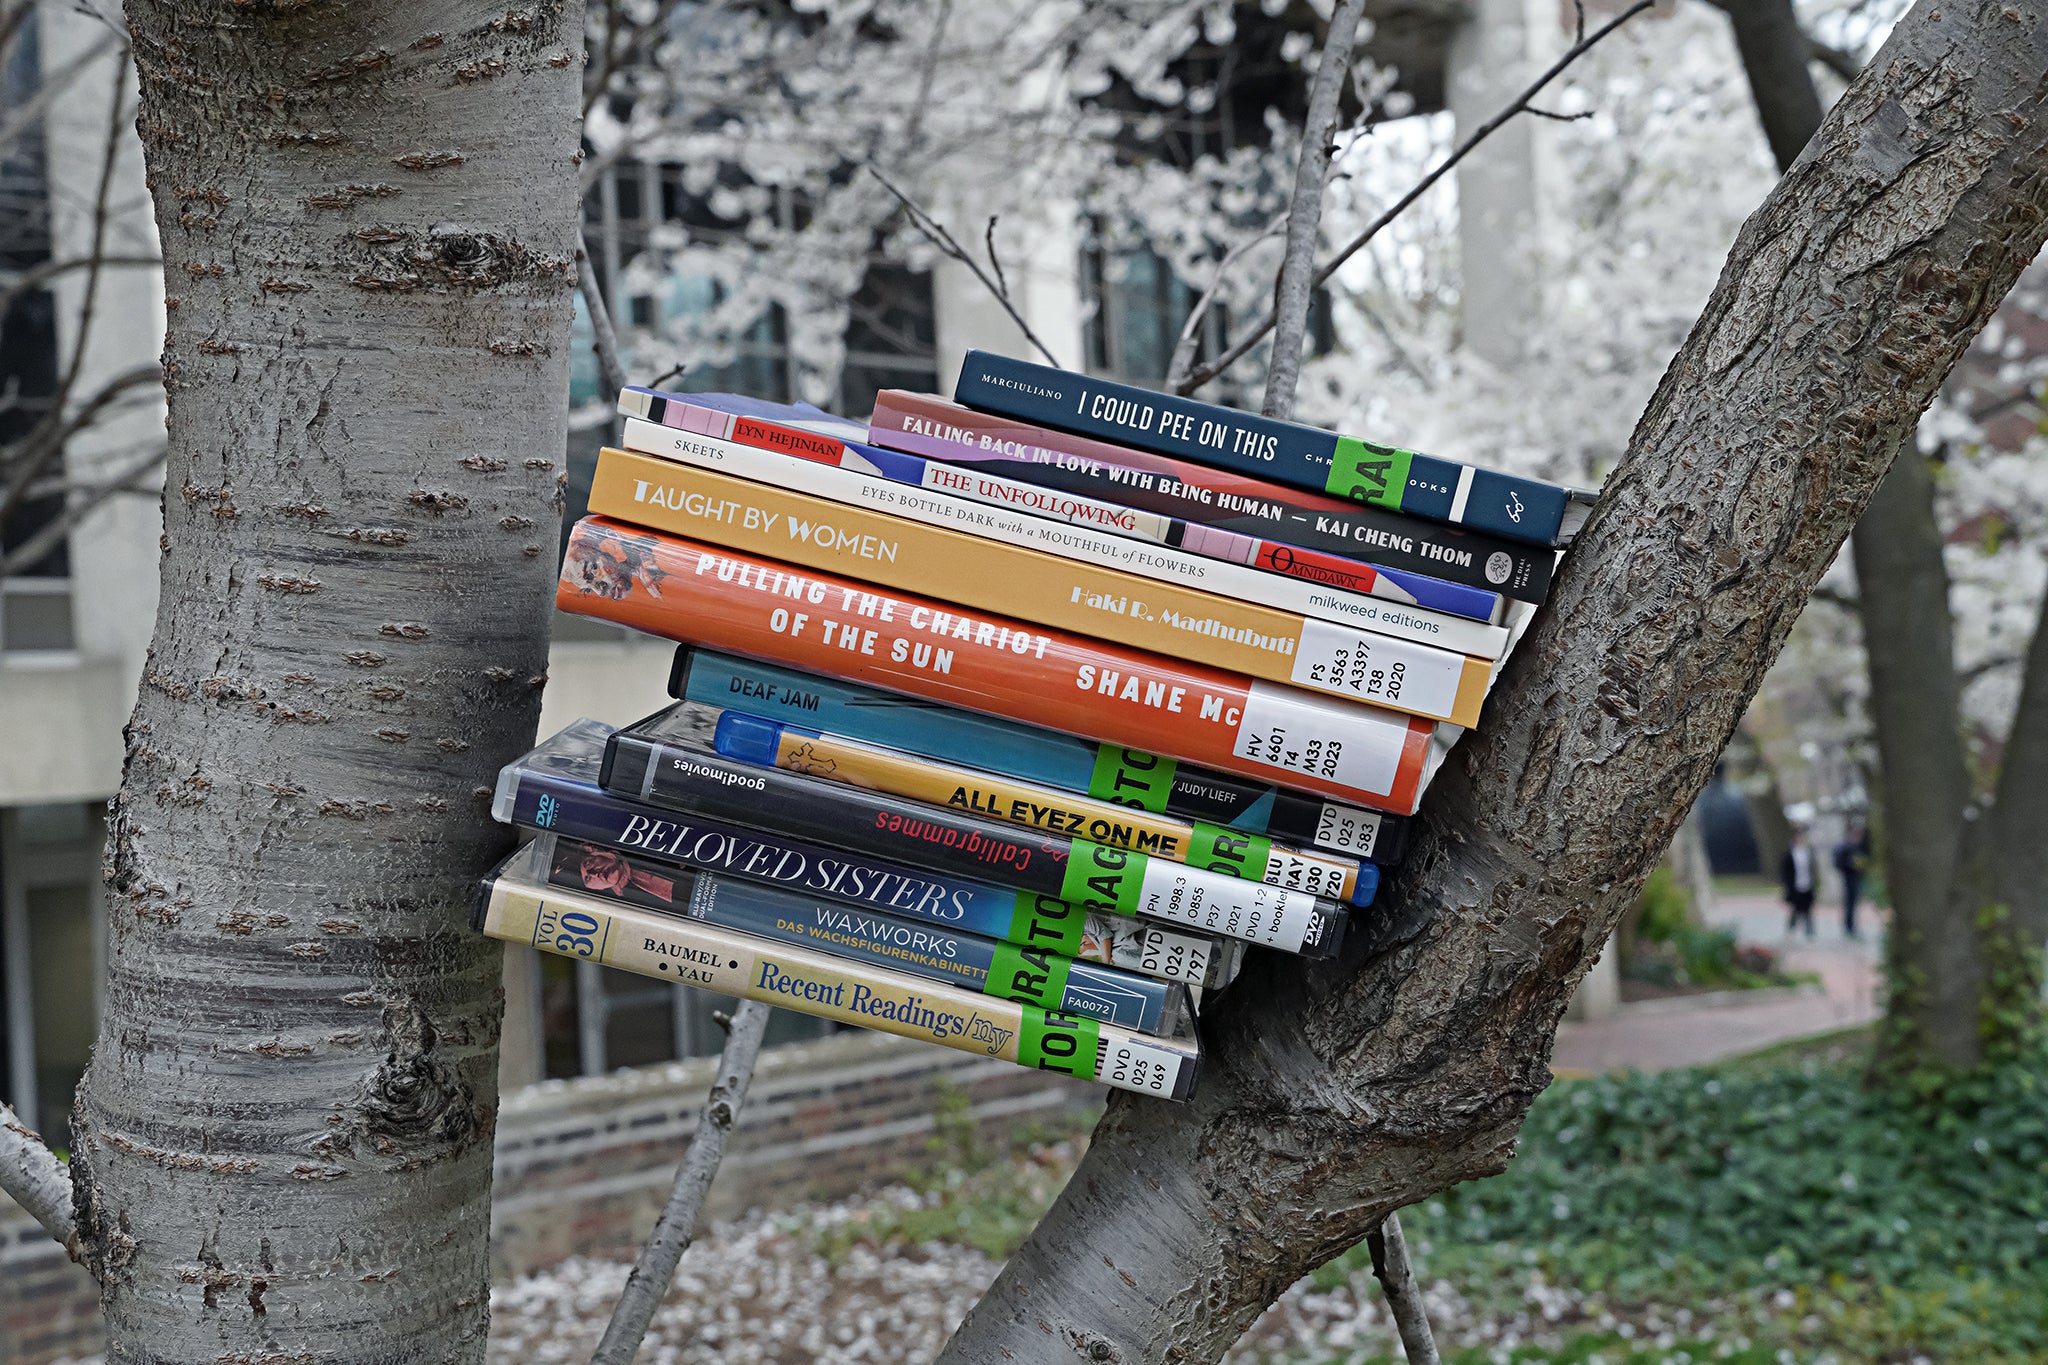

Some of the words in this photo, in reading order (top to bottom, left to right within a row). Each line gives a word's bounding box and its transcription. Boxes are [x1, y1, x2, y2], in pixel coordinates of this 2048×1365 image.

[981, 374, 1062, 400] MARCIULIANO
[736, 423, 766, 443] LYN
[769, 430, 839, 458] HEJINIAN
[1077, 391, 1087, 415] I
[1091, 394, 1152, 431] COULD
[1158, 411, 1192, 441] PEE
[1198, 421, 1230, 449] ON
[1233, 428, 1279, 461] THIS
[674, 439, 725, 460] SKEETS
[1305, 453, 1333, 466] CHR
[1409, 479, 1448, 494] OOKS
[902, 416, 974, 447] FALLING
[979, 435, 1027, 459] BACK
[1033, 447, 1052, 465] IN
[1056, 453, 1103, 477] LOVE
[1108, 466, 1152, 490] WITH
[1157, 479, 1213, 505] BEING
[1217, 492, 1284, 521] HUMAN
[1315, 516, 1350, 538] KAI
[1353, 526, 1414, 553] CHENG
[1420, 541, 1473, 567] THOM
[931, 467, 973, 492] THE
[979, 479, 1136, 531] UNFOLLOWING
[633, 478, 742, 524] TAUGHT
[743, 507, 779, 534] BY
[788, 516, 899, 564] WOMEN
[861, 485, 895, 502] EYES
[899, 494, 952, 517] BOTTLE
[956, 508, 995, 528] DARK
[998, 520, 1023, 534] with
[1027, 528, 1034, 537] a
[1040, 528, 1119, 557] MOUTHFUL
[1122, 548, 1138, 562] of
[1138, 553, 1206, 578] FLOWERS
[1521, 563, 1532, 587] PRESS
[696, 555, 826, 604] PULLING
[841, 587, 901, 623] THE
[910, 606, 1051, 659] CHARIOT
[1070, 586, 1128, 615] Haki
[1129, 601, 1154, 622] R.
[1158, 608, 1295, 656] Madhubuti
[1309, 594, 1377, 620] milkweed
[1382, 612, 1440, 634] editions
[770, 608, 809, 637] OF
[821, 619, 879, 656] THE
[890, 638, 955, 674] SUN
[1310, 663, 1326, 682] PS
[1329, 649, 1349, 686] 3563
[1349, 640, 1371, 690] A3397
[1386, 662, 1406, 700] 2020
[730, 676, 777, 701] DEAF
[780, 689, 820, 712] JAM
[1076, 664, 1187, 713] SHANE
[1367, 670, 1384, 695] T38
[1246, 733, 1263, 757] HV
[1266, 727, 1286, 762] 6601
[1284, 751, 1299, 767] T4
[1302, 740, 1322, 773] M33
[1321, 741, 1343, 778] 2023
[674, 758, 766, 791] good!movies
[536, 793, 549, 826] DVD
[1178, 782, 1208, 798] JUDY
[1208, 788, 1238, 804] LIEFF
[948, 786, 1002, 816] ALL
[1009, 801, 1086, 835] EYEZ
[1090, 819, 1133, 847] ON
[1136, 829, 1179, 857] ME
[1318, 807, 1337, 842] DVD
[1337, 818, 1355, 846] 025
[1357, 823, 1374, 852] 583
[876, 811, 1032, 871] Calligrammes
[615, 814, 807, 882] BELOVED
[805, 858, 975, 920] SISTERS
[1265, 858, 1283, 884] BLU
[1285, 858, 1304, 888] RAY
[1305, 866, 1323, 893] 030
[707, 883, 718, 911] EDITION
[1168, 876, 1187, 916] 1998.3
[1325, 870, 1343, 899] 720
[1147, 893, 1161, 912] PN
[1206, 904, 1221, 928] P37
[1226, 905, 1243, 933] 2021
[1245, 910, 1262, 939] DVD
[1254, 888, 1268, 908] 1-2
[1269, 890, 1289, 933] booklet
[538, 910, 557, 944] VOL
[556, 911, 599, 957] 30
[816, 907, 958, 958] WAXWORKS
[1304, 911, 1319, 945] DVD
[643, 937, 721, 968] BAUMEL
[776, 918, 804, 934] DAS
[809, 927, 988, 980] WACHSFIGURENKABINETT
[1142, 931, 1164, 971] DVD
[1165, 945, 1184, 976] 026
[1187, 948, 1207, 981] 797
[676, 965, 714, 984] YAU
[756, 961, 845, 1007] Recent
[1067, 996, 1110, 1015] FA0072
[1112, 1049, 1131, 1081] DVD
[1131, 1059, 1148, 1086] 025
[1150, 1064, 1166, 1090] 069
